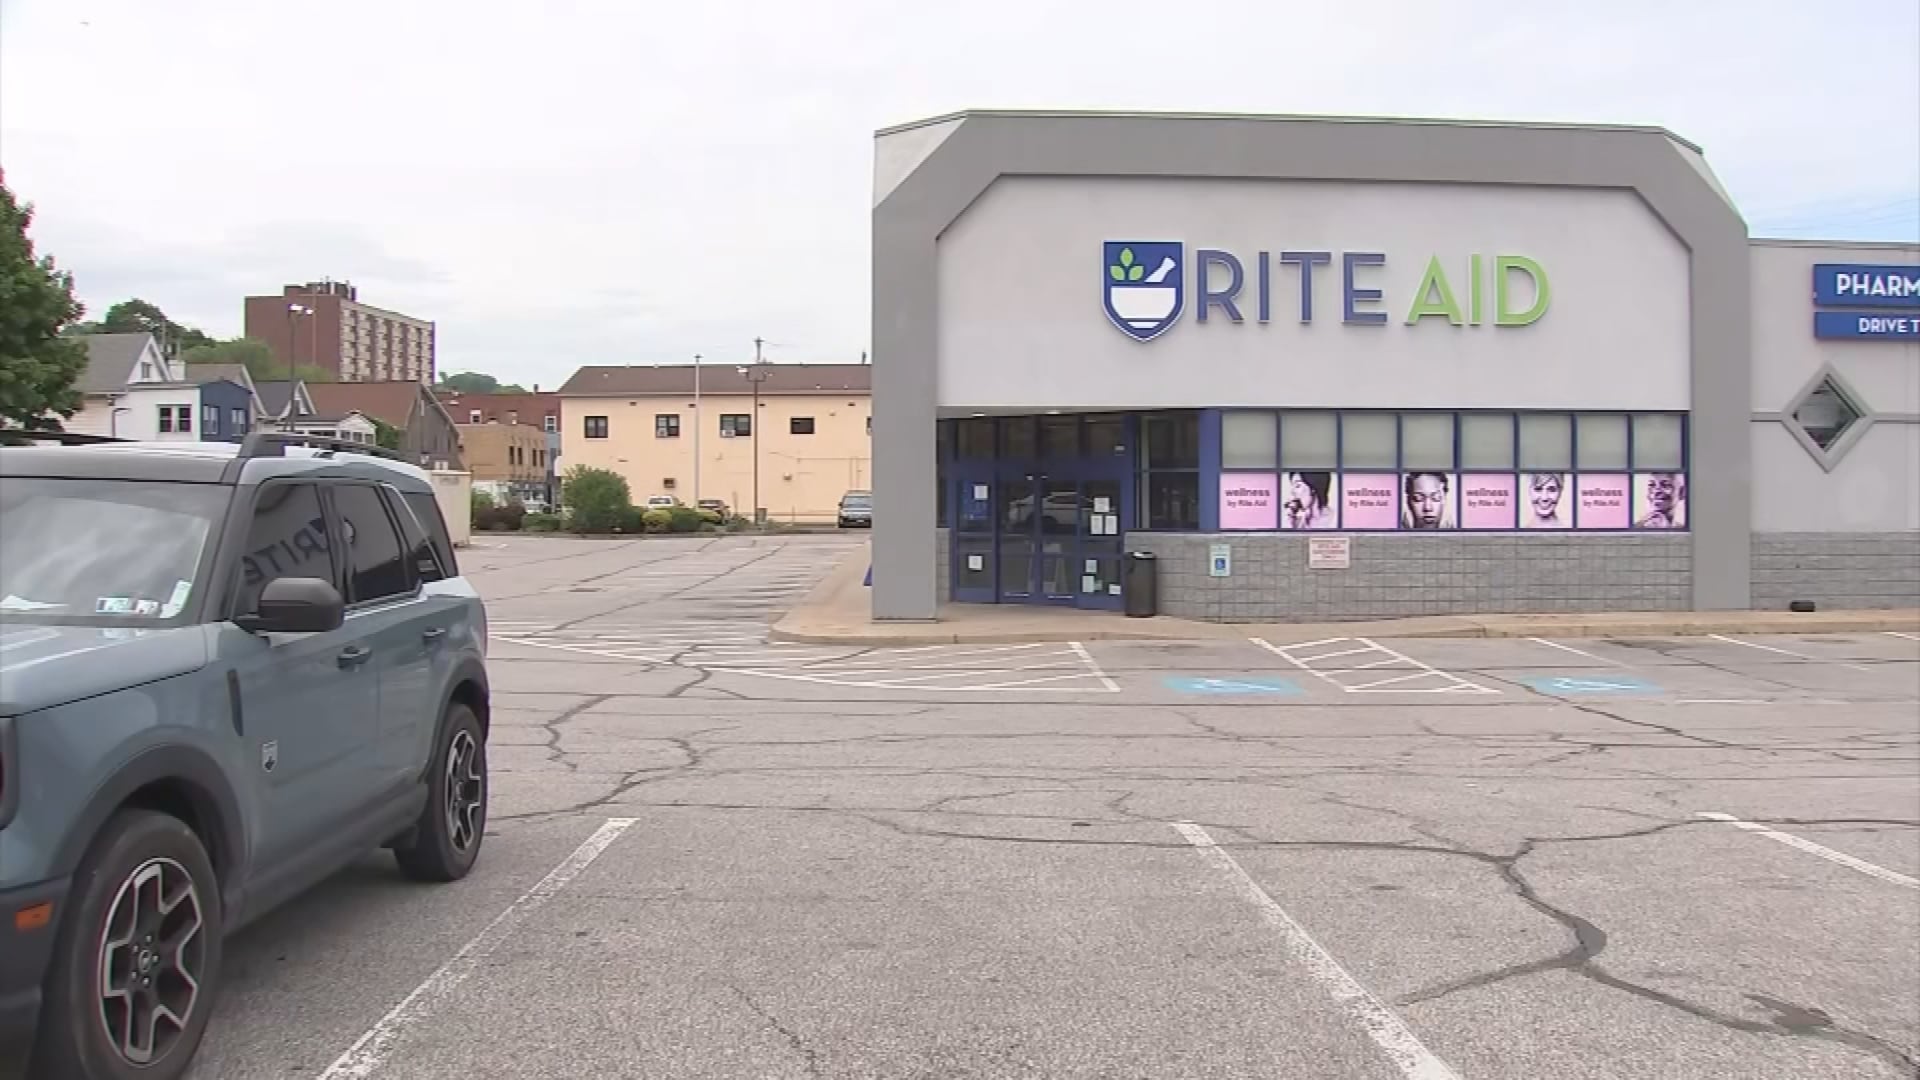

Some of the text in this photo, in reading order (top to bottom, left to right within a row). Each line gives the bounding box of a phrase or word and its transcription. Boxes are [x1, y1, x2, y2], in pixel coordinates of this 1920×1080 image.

[1196, 249, 1551, 327] RITE AID
[1836, 273, 1920, 297] PHARM
[1858, 317, 1908, 333] DRIVE
[1225, 487, 1270, 497] wellness
[1347, 487, 1392, 497] wellness
[1466, 487, 1509, 497] wellness
[1581, 487, 1624, 497] wellness
